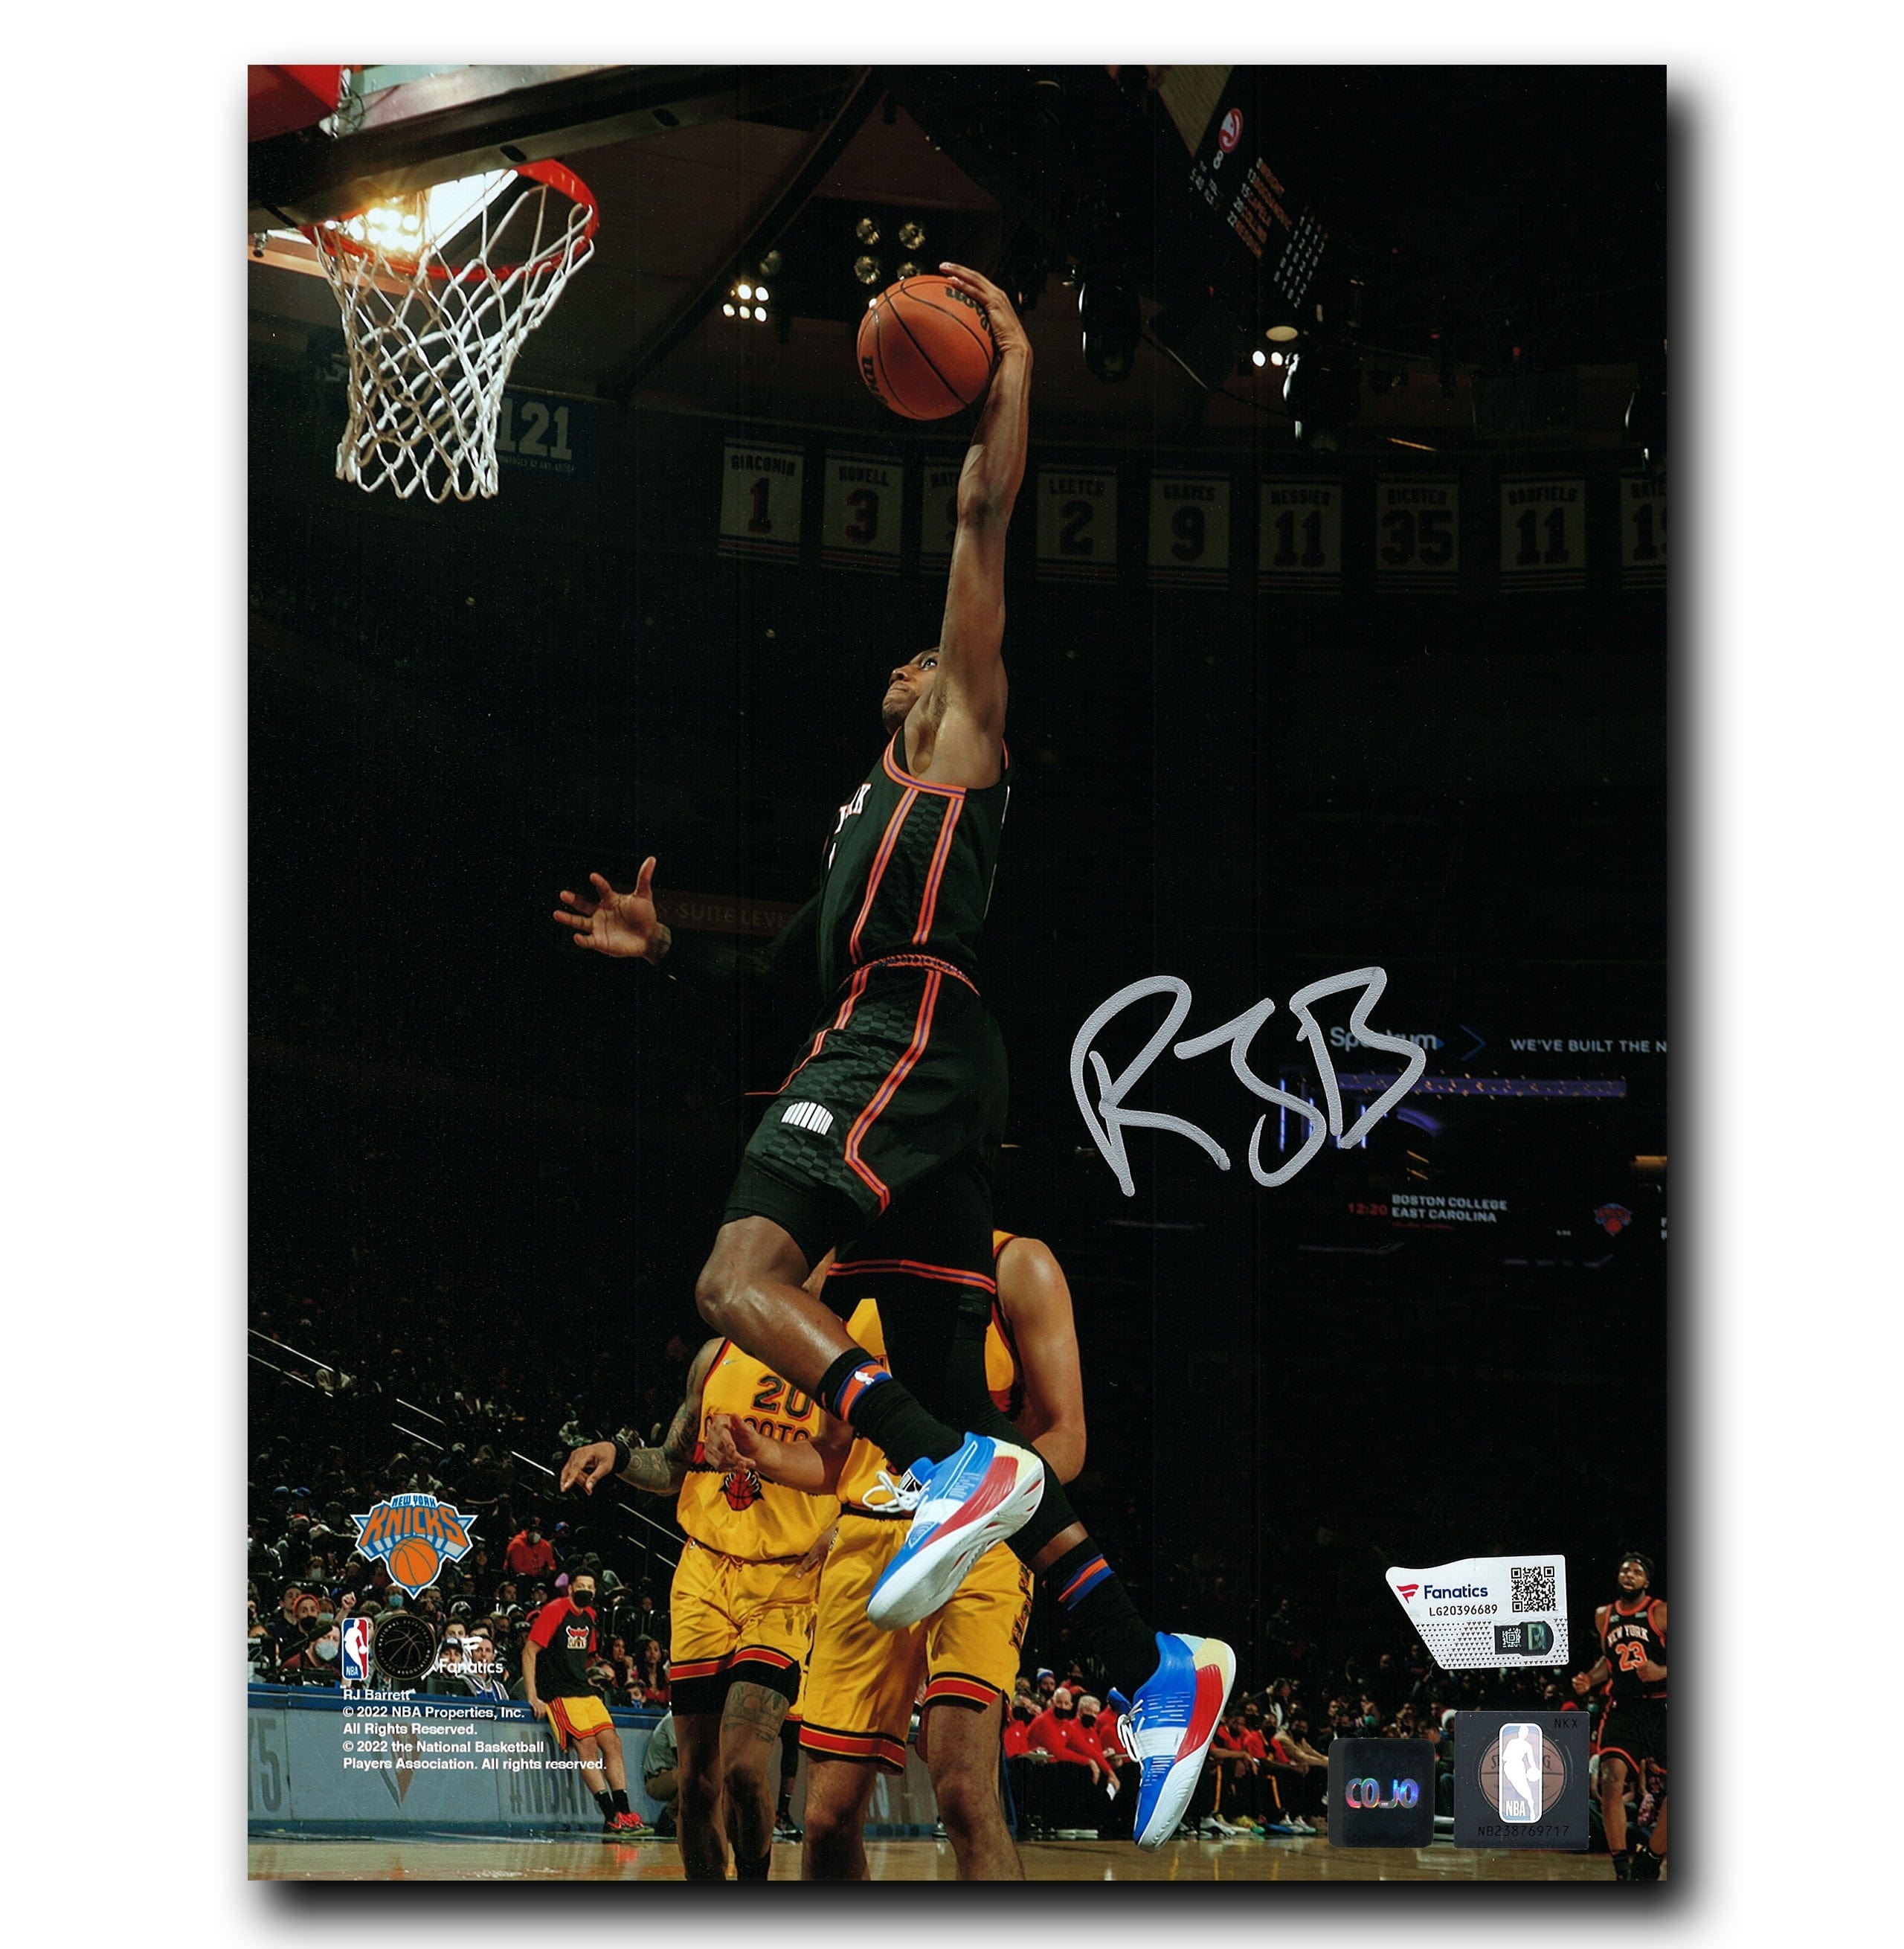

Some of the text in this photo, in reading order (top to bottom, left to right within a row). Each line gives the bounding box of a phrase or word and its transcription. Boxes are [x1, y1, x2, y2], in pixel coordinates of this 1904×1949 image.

[748, 477, 771, 533] 1
[846, 488, 879, 544] 3
[1060, 500, 1093, 555] 2
[1171, 506, 1205, 561] 9
[1275, 510, 1325, 567] 11
[1382, 509, 1453, 565] 35
[1517, 507, 1569, 565] 11
[1633, 504, 1667, 561] 1
[1510, 1038, 1563, 1053] WE'VE
[1569, 1038, 1615, 1053] BUILT
[1618, 1039, 1650, 1053] THE
[1392, 1193, 1508, 1212] BOSTON COLLEGE
[1392, 1205, 1498, 1224] EAST CAROLINA
[750, 1375, 814, 1422] 20
[1424, 1584, 1488, 1599] Fanatics
[1429, 1604, 1498, 1616] LG20396689
[1625, 1624, 1650, 1643] YORK
[1615, 1640, 1648, 1672] 23
[1554, 1718, 1578, 1729] NKX
[1505, 1800, 1525, 1817] NBA
[1477, 1825, 1569, 1837] NB238769717
